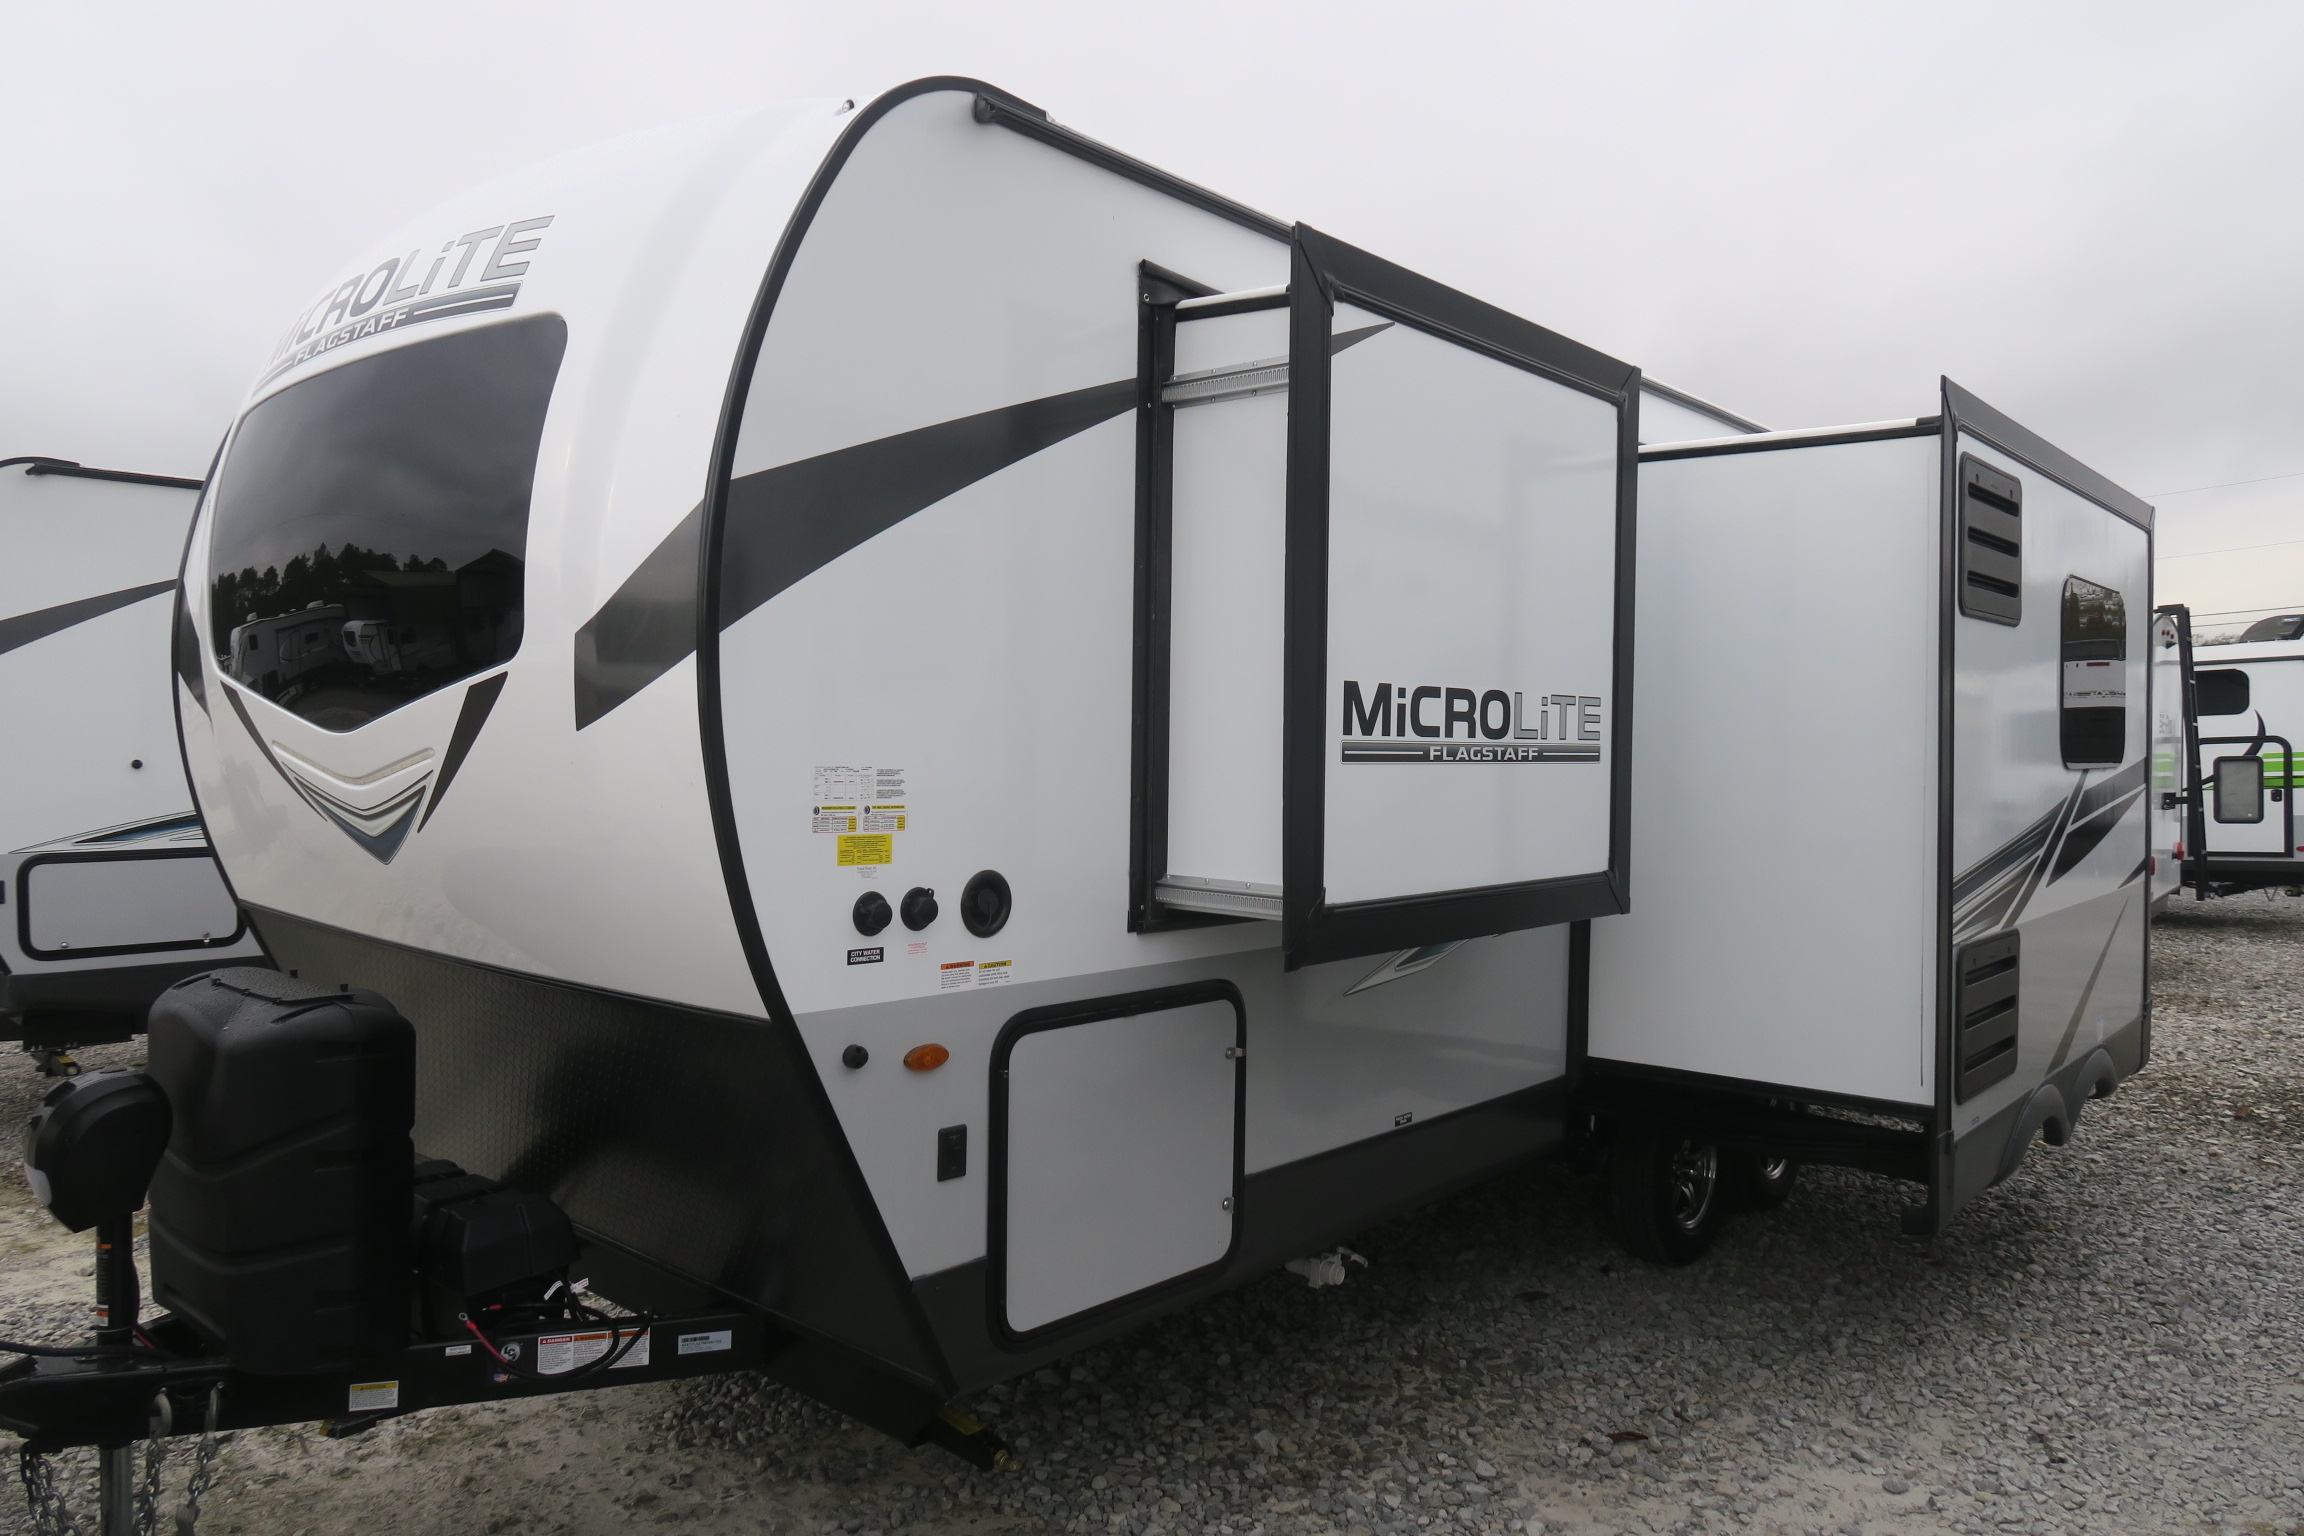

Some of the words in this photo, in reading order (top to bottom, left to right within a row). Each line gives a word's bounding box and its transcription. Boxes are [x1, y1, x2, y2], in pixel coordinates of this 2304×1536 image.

[293, 308, 409, 367] FLAGSTAFF
[1429, 746, 1539, 761] FLAGSTAFF
[863, 948, 881, 956] WATER
[850, 954, 881, 963] CONNECTION
[547, 1336, 571, 1344] DANGER
